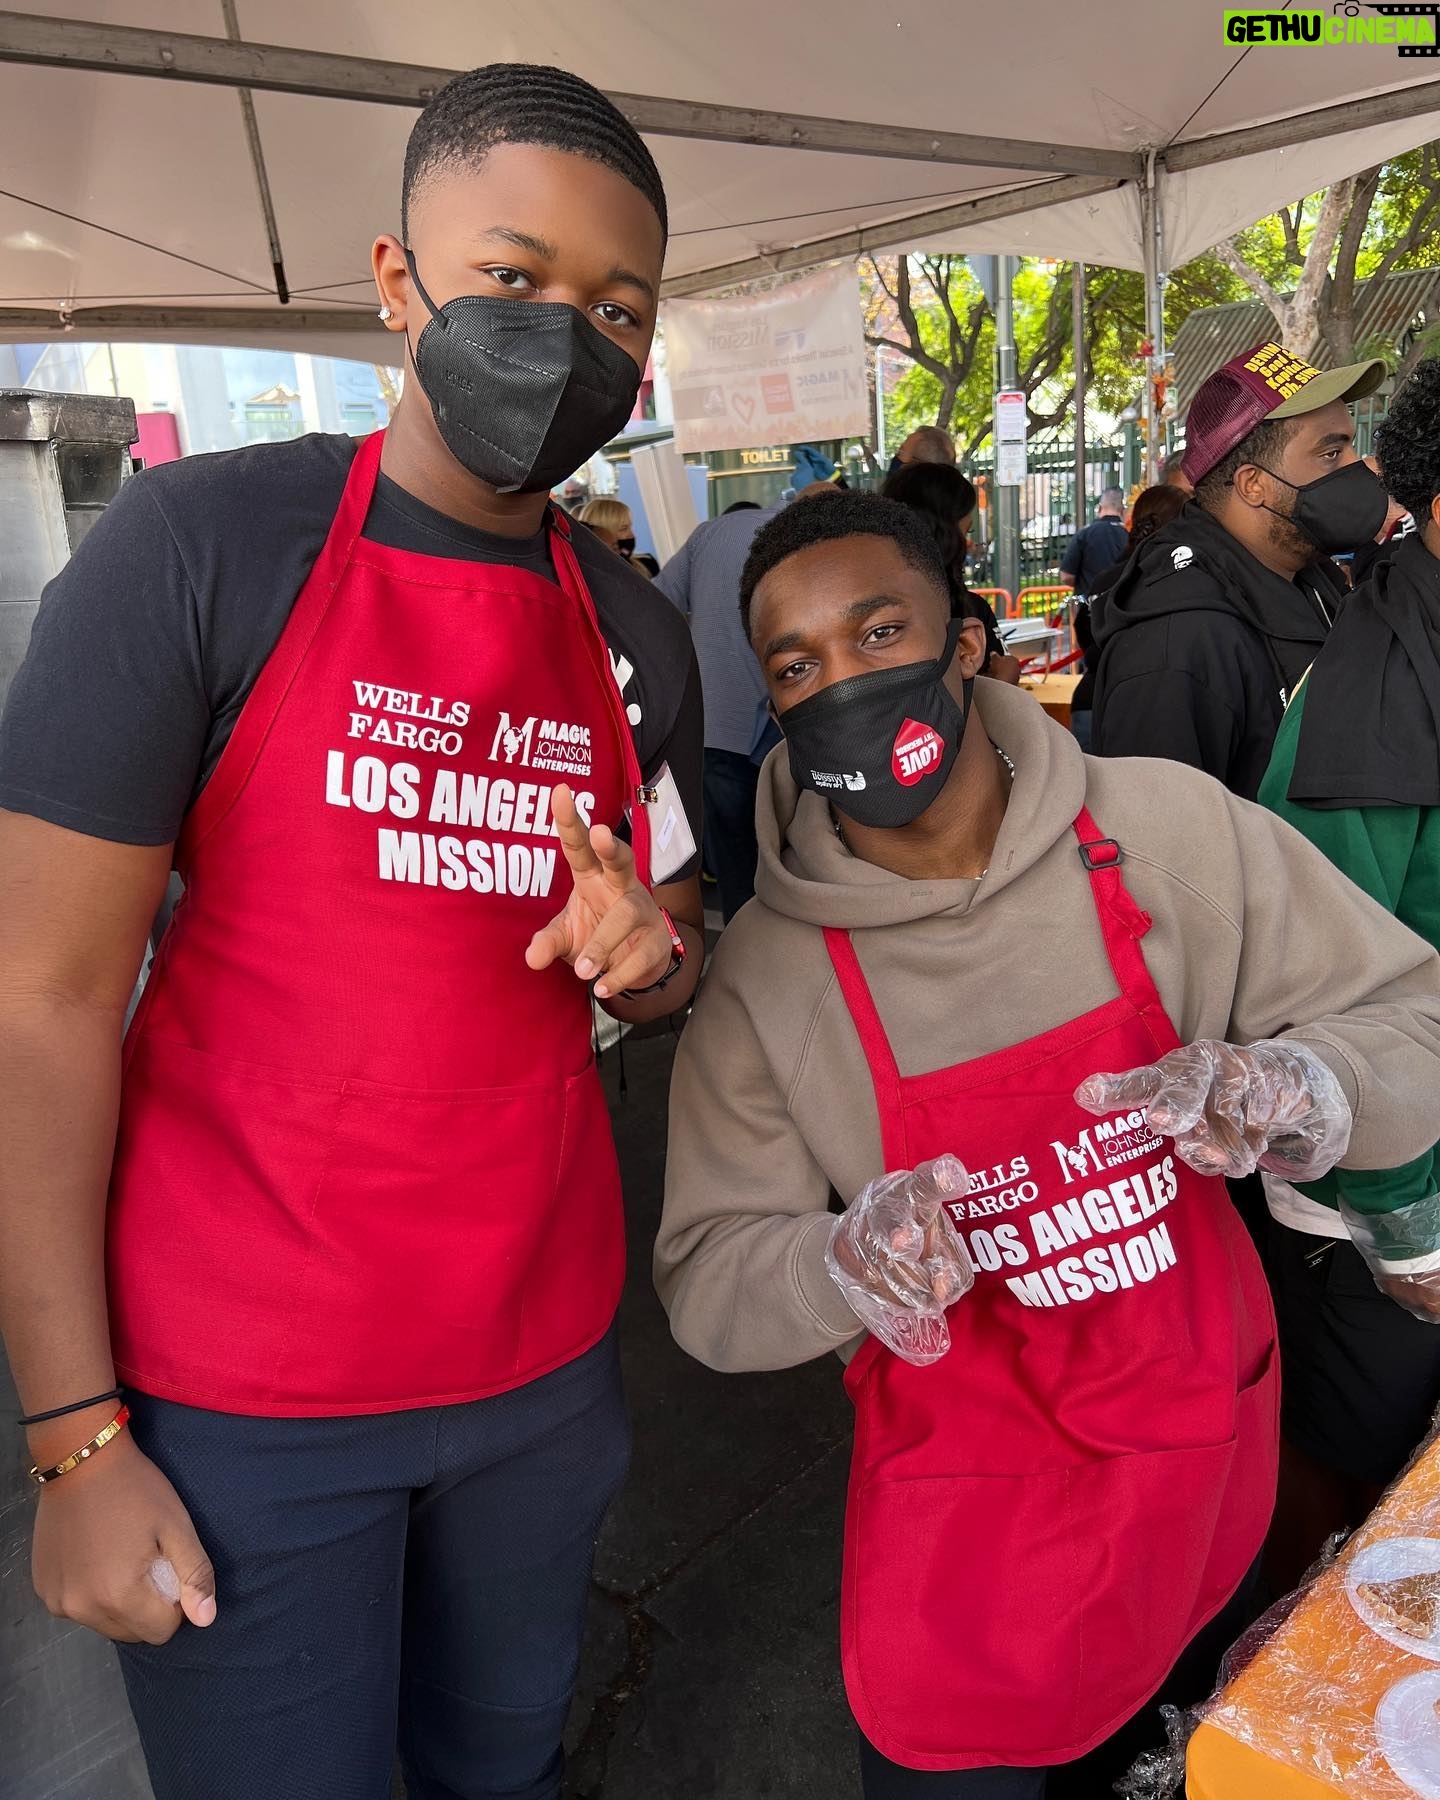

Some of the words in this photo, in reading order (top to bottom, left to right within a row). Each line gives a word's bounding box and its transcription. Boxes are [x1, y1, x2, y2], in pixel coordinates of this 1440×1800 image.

[1243, 342, 1282, 374] DENIM
[741, 449, 791, 464] TOILET
[352, 680, 471, 727] WELLS
[347, 712, 463, 756] FARGO
[538, 719, 591, 747] MAGIC
[532, 757, 591, 776] ENTERPRISES
[535, 741, 592, 763] JOHNSON
[898, 741, 939, 778] LOVE
[326, 749, 421, 819] LOS
[428, 769, 595, 838] ANGELS
[378, 828, 556, 897] MISSION
[1094, 1107, 1149, 1142] MAGI
[1102, 1127, 1156, 1156] JOHNSO
[1106, 1135, 1164, 1168] ENTERPRISES
[966, 1155, 1030, 1195] ELLS
[948, 1180, 1039, 1220] FARGO
[1029, 1155, 1178, 1257] ANGELES
[1005, 1221, 1177, 1307] MISSION
